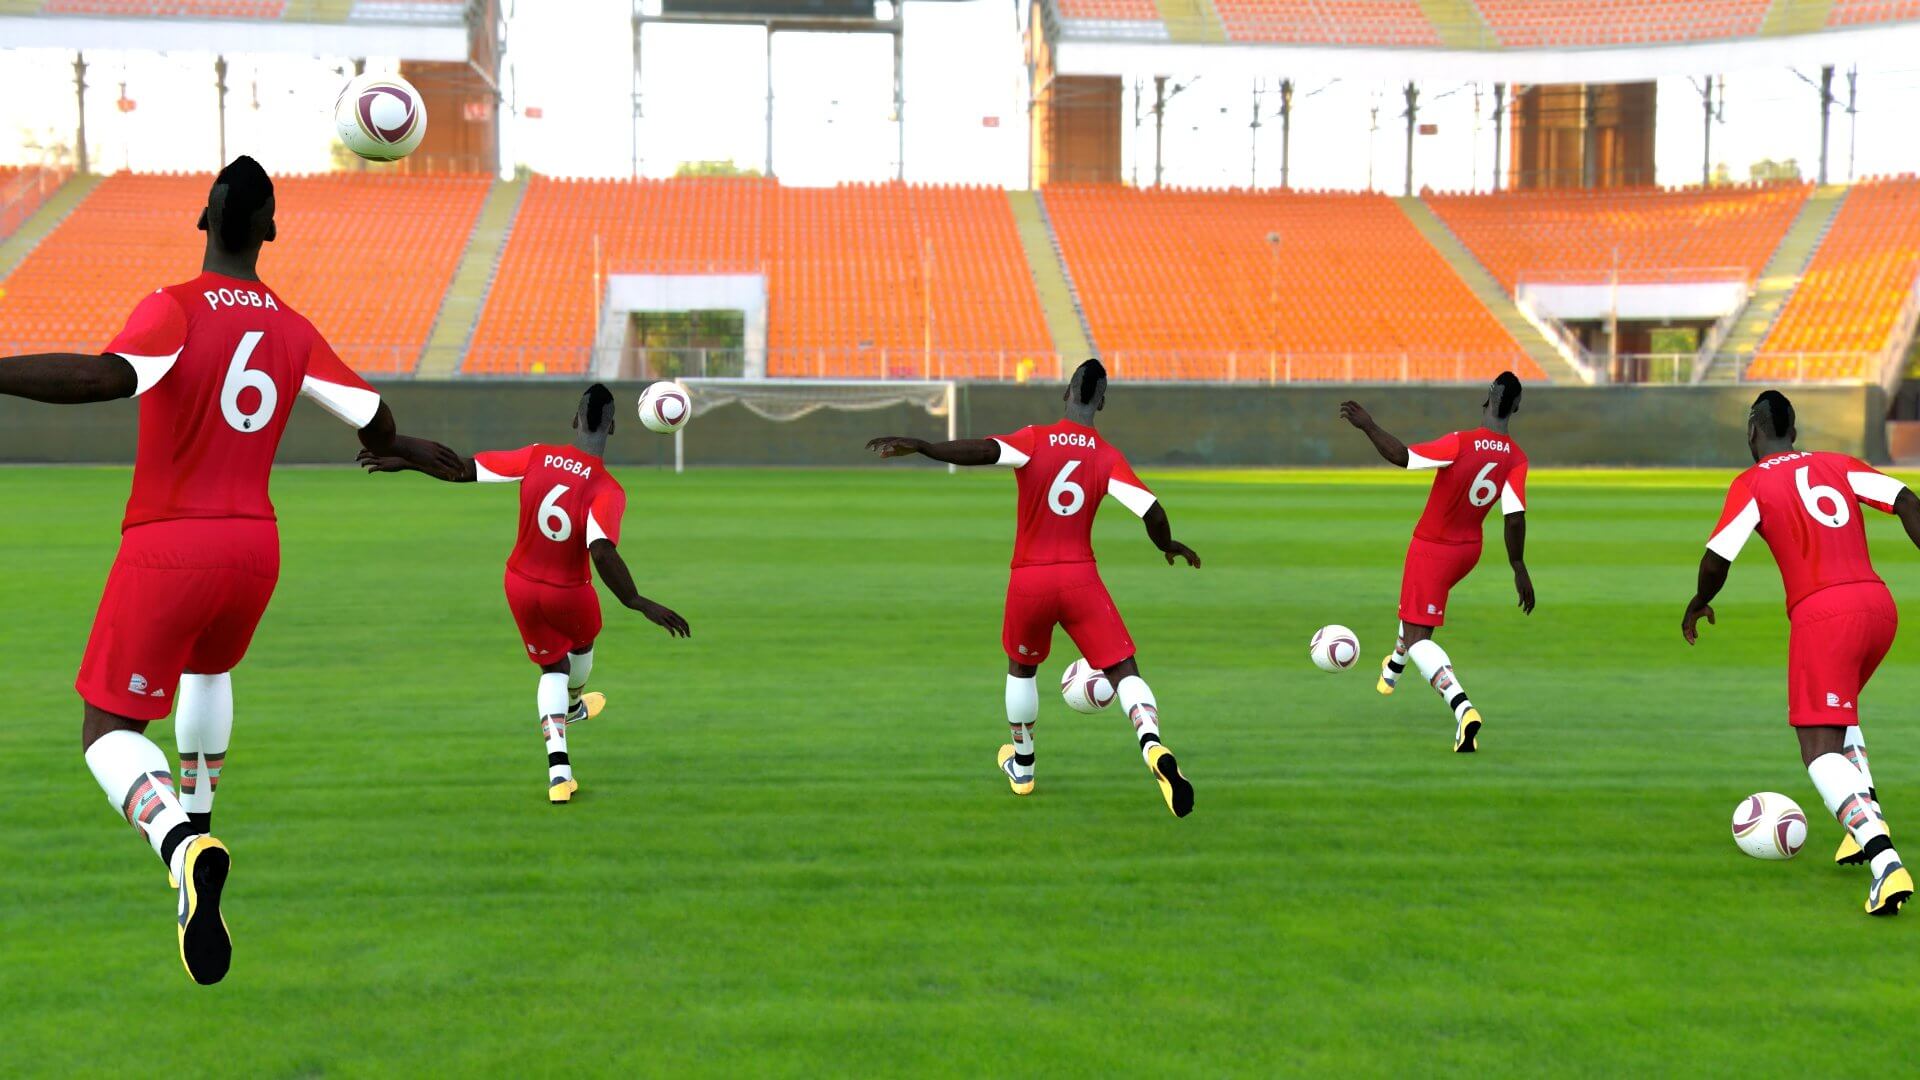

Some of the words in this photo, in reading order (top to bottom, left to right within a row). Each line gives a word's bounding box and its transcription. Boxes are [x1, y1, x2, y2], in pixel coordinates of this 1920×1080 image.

[203, 287, 279, 311] POGBA
[220, 331, 278, 433] 6
[1048, 432, 1096, 450] POGBA
[1474, 439, 1510, 454] POGBA
[544, 454, 592, 480] POGBA
[1758, 451, 1813, 470] POGBA
[1047, 459, 1085, 516] 6
[1468, 462, 1498, 507] 6
[1794, 465, 1850, 529] 6
[537, 483, 572, 542] 6
